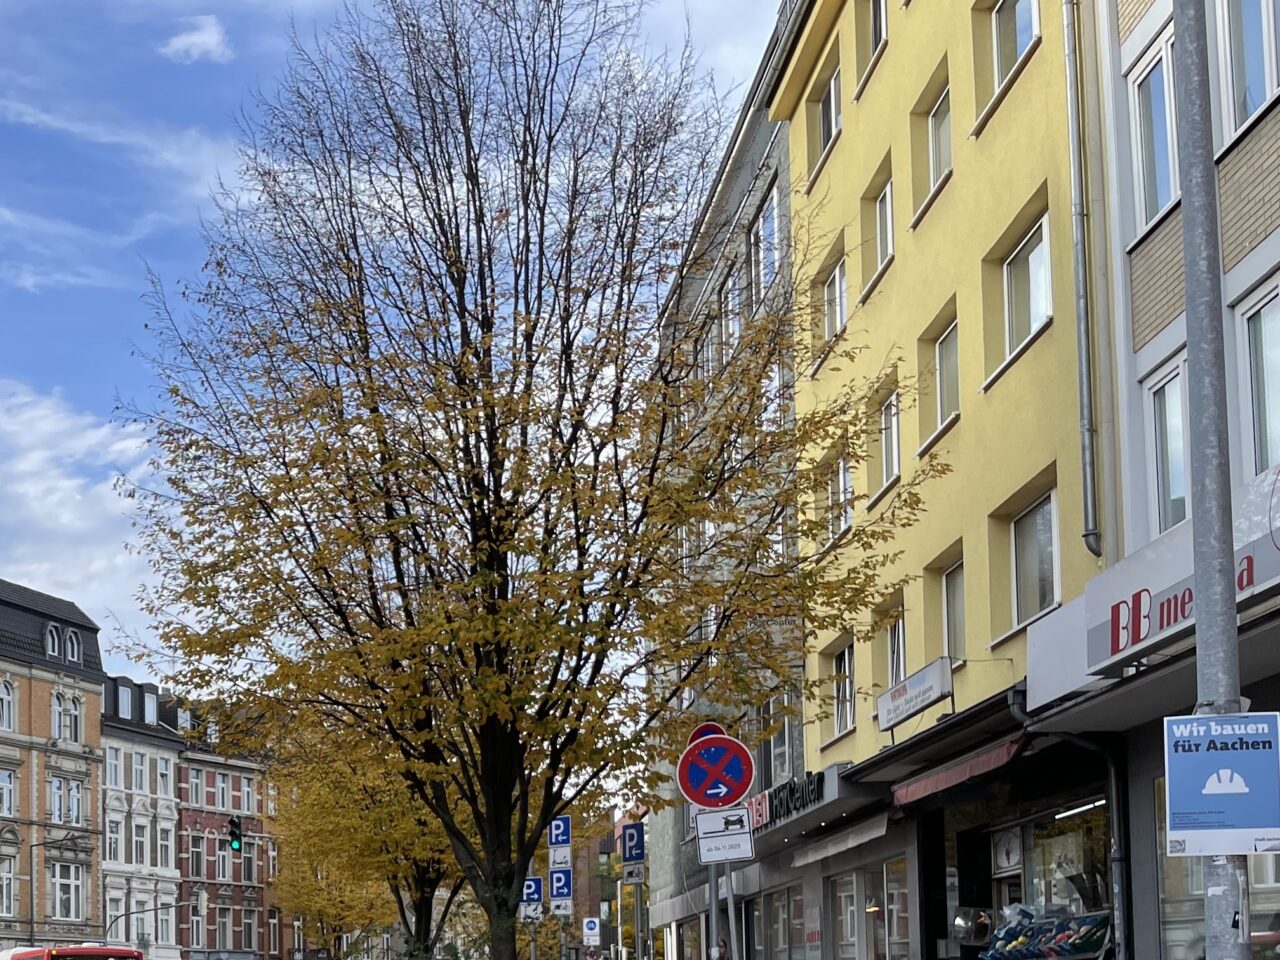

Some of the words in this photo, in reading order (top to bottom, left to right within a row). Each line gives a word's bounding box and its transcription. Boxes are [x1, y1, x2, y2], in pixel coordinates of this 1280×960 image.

[1111, 588, 1152, 657] BB
[1172, 722, 1206, 738] Wir
[1209, 722, 1269, 736] bauen
[1173, 740, 1202, 753] für
[1206, 737, 1273, 752] Aachen
[551, 820, 564, 843] P
[625, 828, 638, 858] P
[523, 881, 535, 900] P
[553, 873, 565, 895] P
